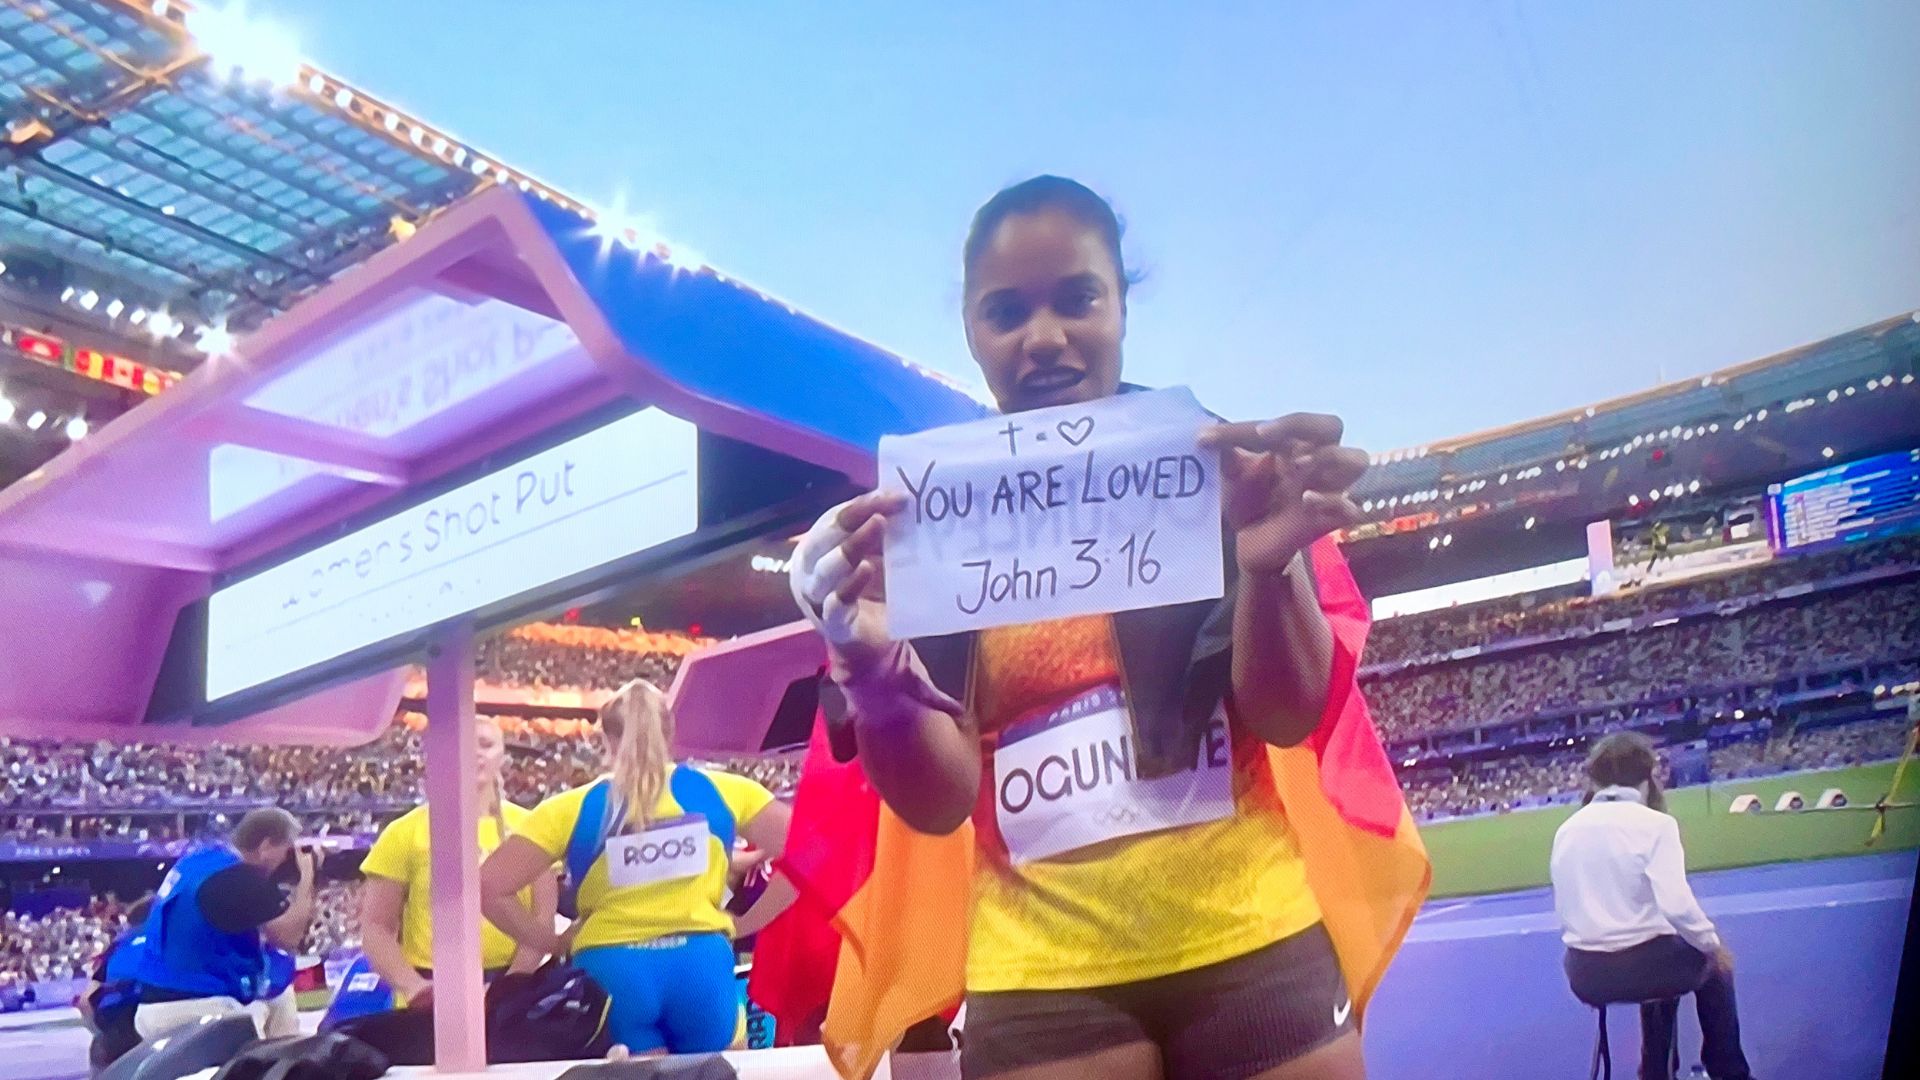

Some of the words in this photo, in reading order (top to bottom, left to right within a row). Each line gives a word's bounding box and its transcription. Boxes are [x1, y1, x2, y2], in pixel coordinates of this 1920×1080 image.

[424, 494, 501, 552] Shot
[515, 459, 576, 514] Put
[896, 459, 973, 524] YOU
[991, 464, 1067, 515] ARE
[1081, 450, 1206, 504] LOVED
[956, 557, 1058, 615] John
[1069, 530, 1162, 590] 3:16
[623, 836, 697, 867] ROOS
